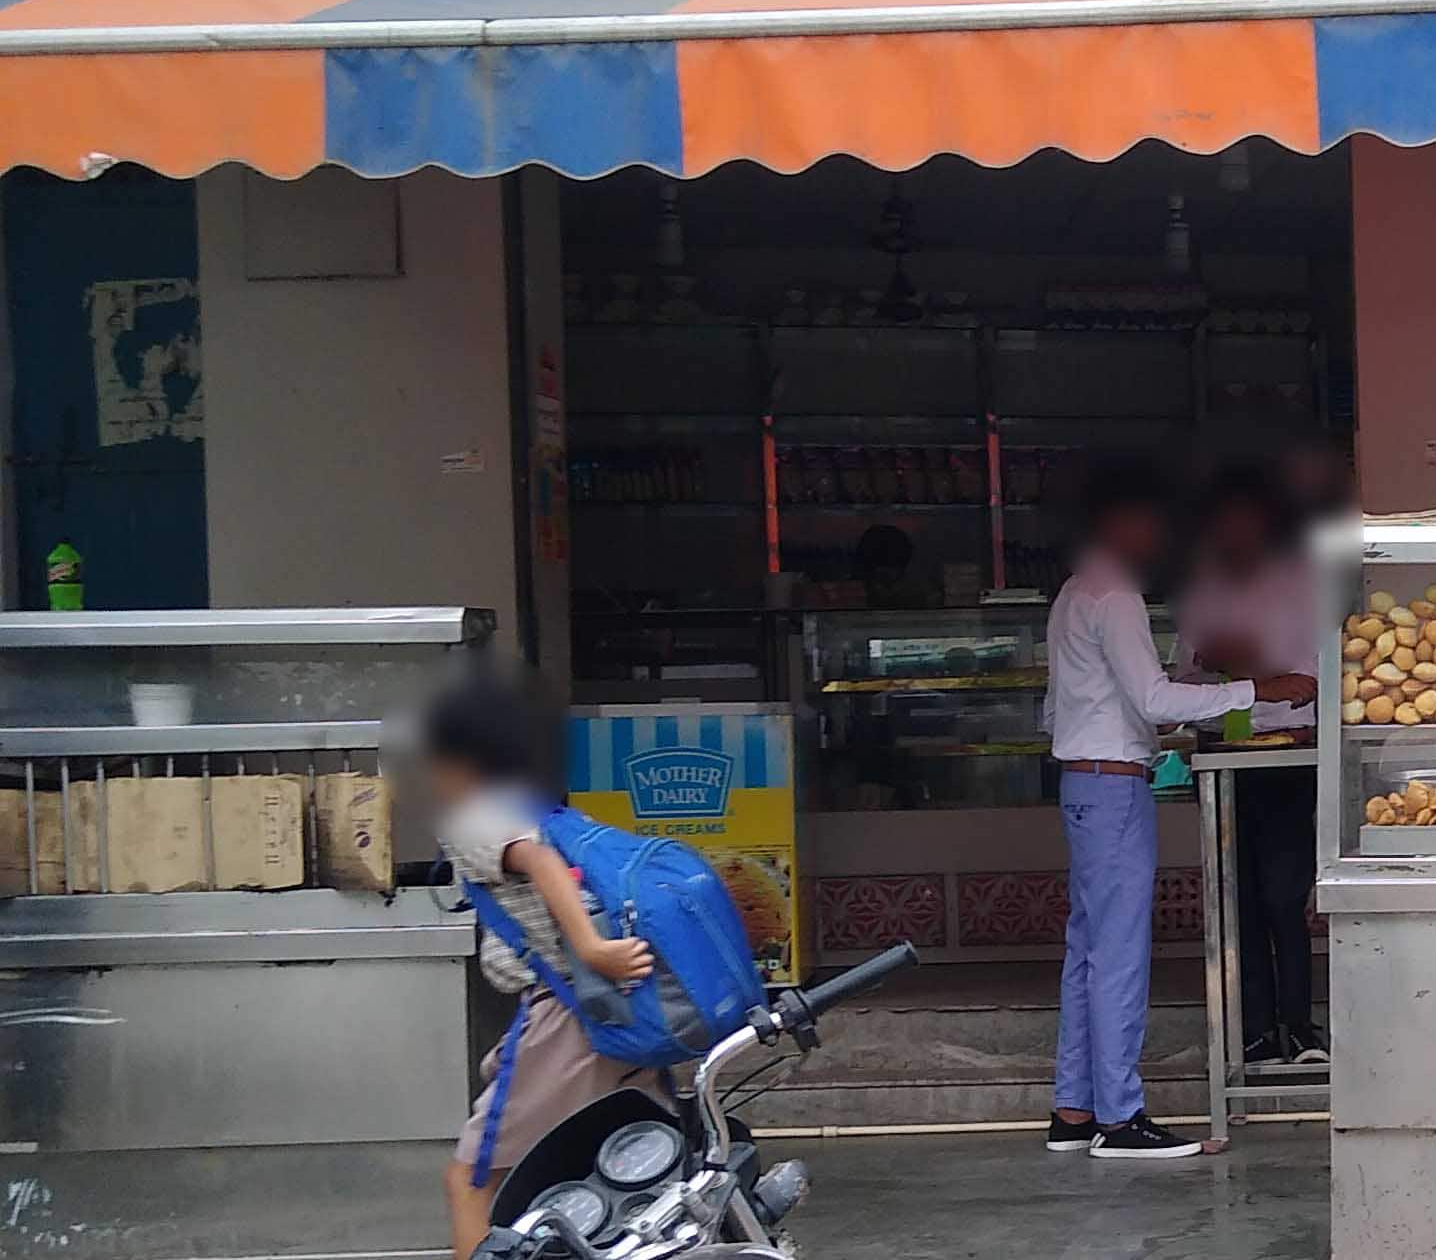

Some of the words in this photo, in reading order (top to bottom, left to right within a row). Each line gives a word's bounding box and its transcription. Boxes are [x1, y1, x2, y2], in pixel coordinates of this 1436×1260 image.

[636, 766, 722, 789] MOTHER
[653, 788, 708, 804] DAIRY
[636, 825, 658, 836] ICE
[665, 823, 726, 835] CREAMS
